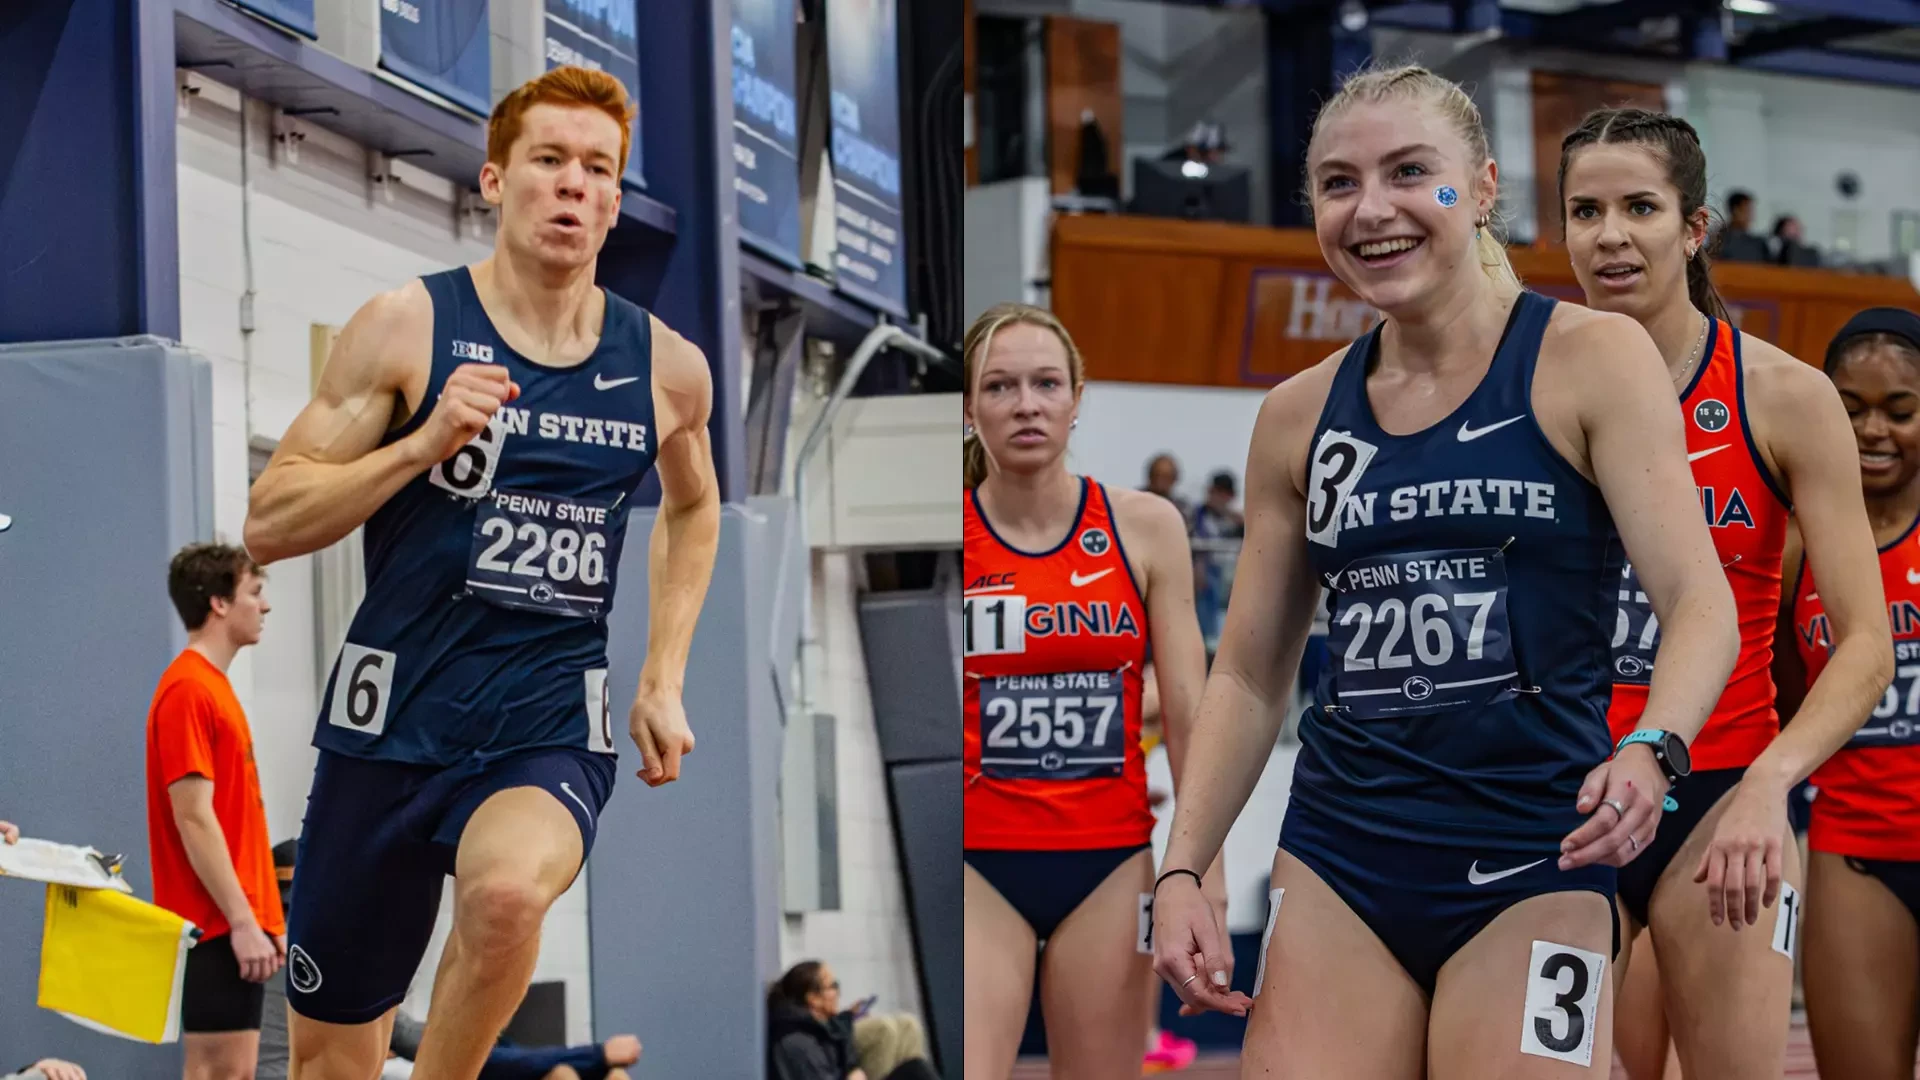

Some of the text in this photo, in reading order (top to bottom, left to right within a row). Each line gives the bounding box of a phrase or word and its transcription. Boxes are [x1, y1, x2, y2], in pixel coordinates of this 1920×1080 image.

[539, 412, 647, 451] STATE
[441, 424, 493, 489] 6
[496, 494, 606, 524] PENN STATE
[1309, 442, 1357, 533] 3
[1390, 479, 1555, 522] STATE
[476, 517, 606, 586] 2286
[1349, 557, 1487, 590] PENN STATE
[966, 572, 1017, 590] ACC
[1025, 601, 1140, 639] GINIA
[1340, 591, 1498, 672] 2267
[346, 653, 383, 726] 6
[995, 671, 1110, 690] PENN STATE
[986, 696, 1118, 749] 2557
[1534, 953, 1589, 1053] 3
